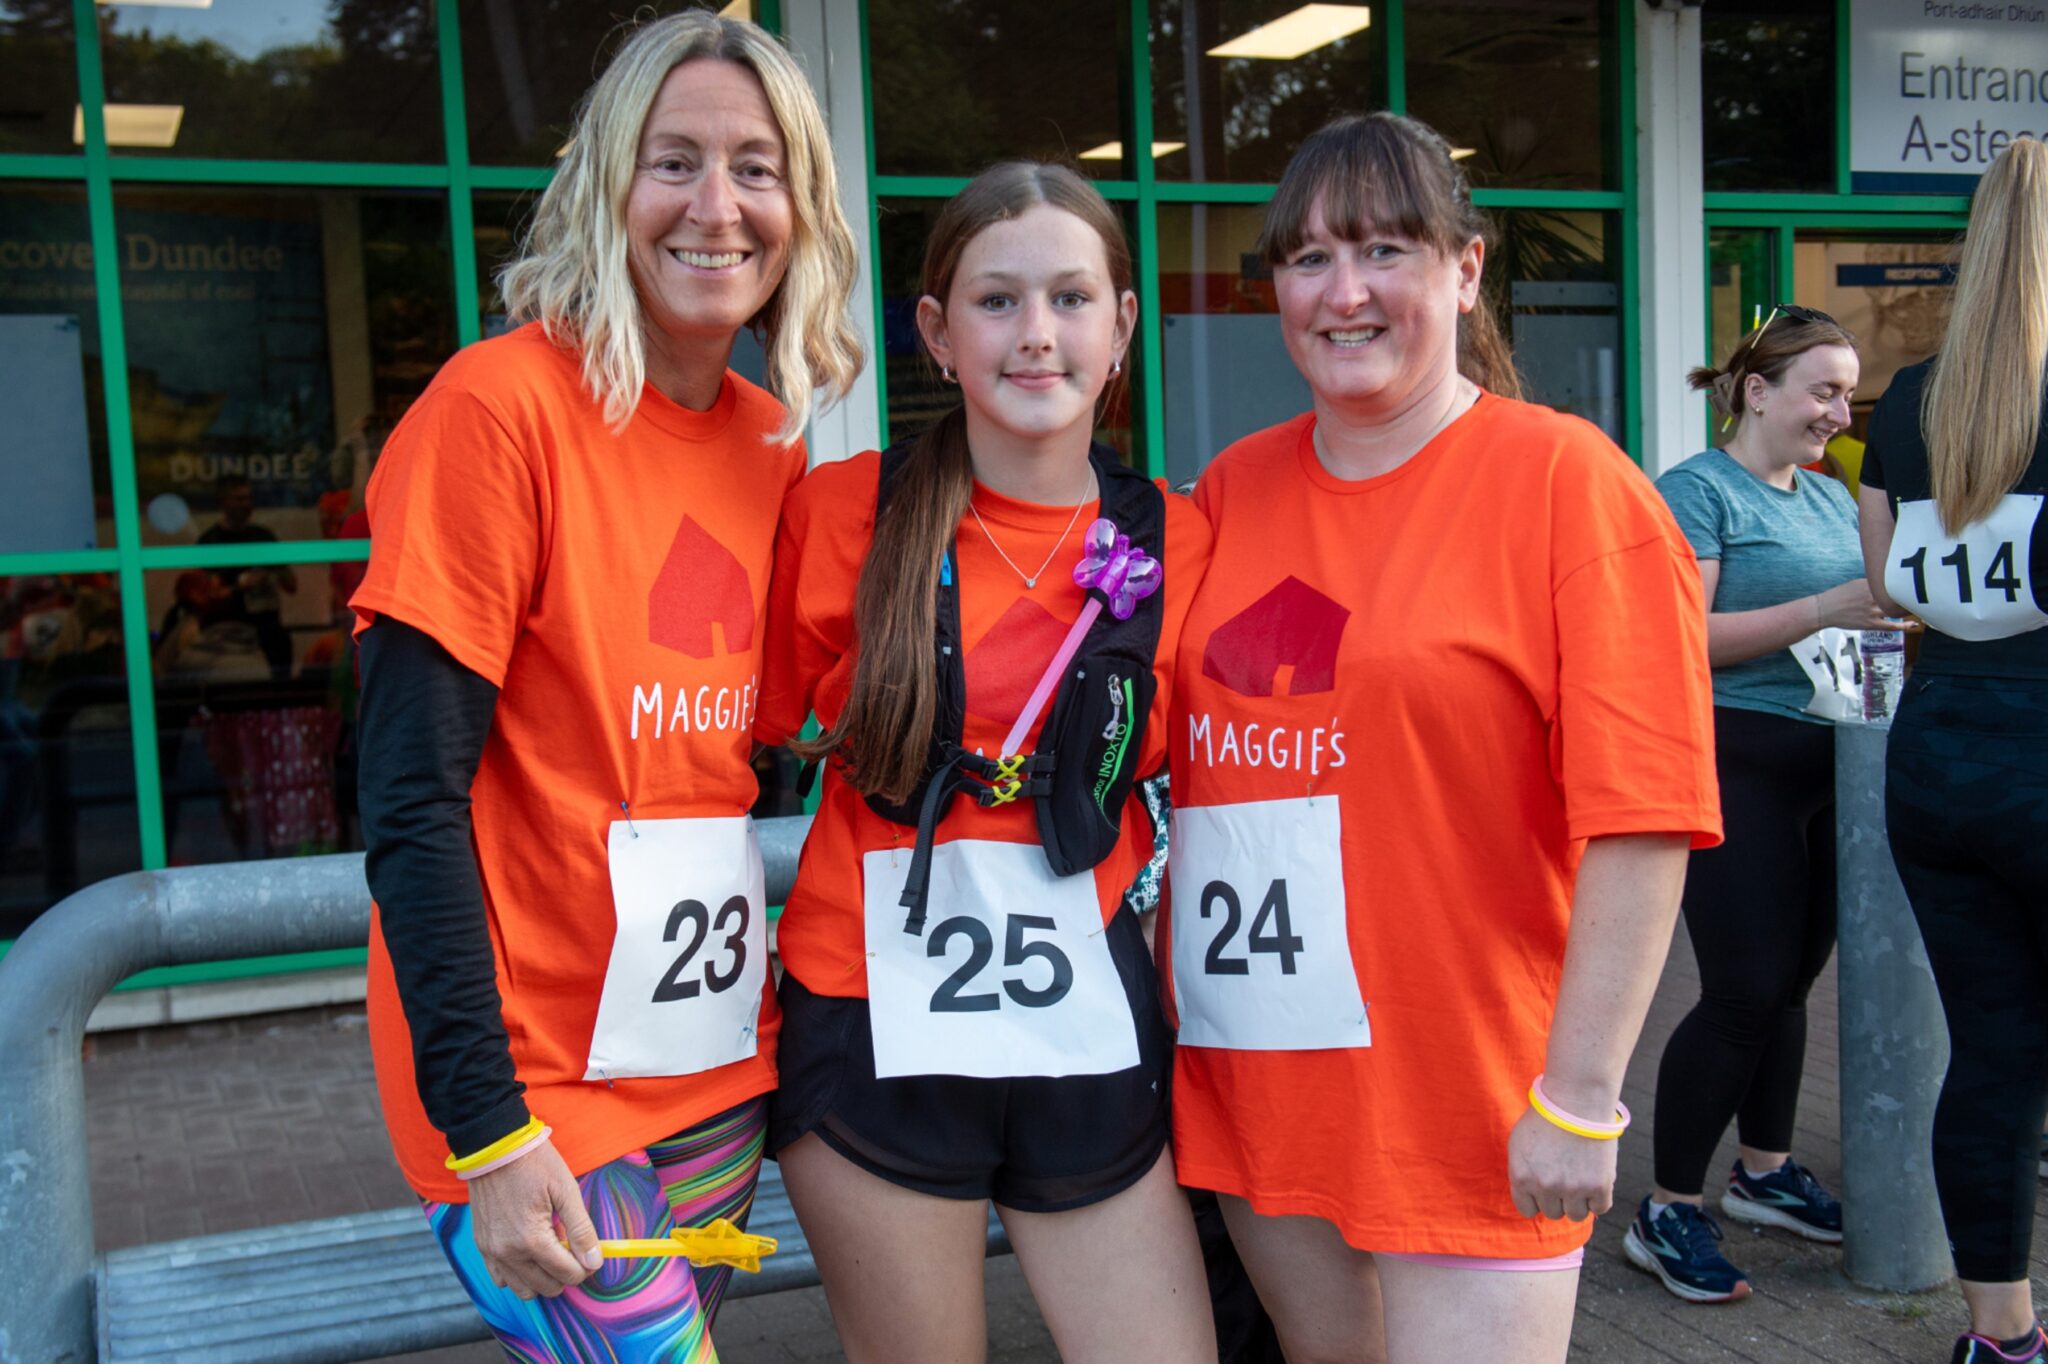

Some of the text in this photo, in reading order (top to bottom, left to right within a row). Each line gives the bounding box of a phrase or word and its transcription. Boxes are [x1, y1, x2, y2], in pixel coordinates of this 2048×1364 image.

[1924, 0, 2004, 20] Port-adhair
[1901, 114, 2048, 164] A-ste
[0, 233, 284, 271] cove Dundee
[169, 452, 312, 482] DUNDEE
[1900, 541, 2021, 604] 114
[1189, 713, 1346, 775] MAGGIE'S
[652, 895, 749, 1003] 23
[1200, 878, 1304, 975] 24
[926, 914, 1073, 1013] 25
